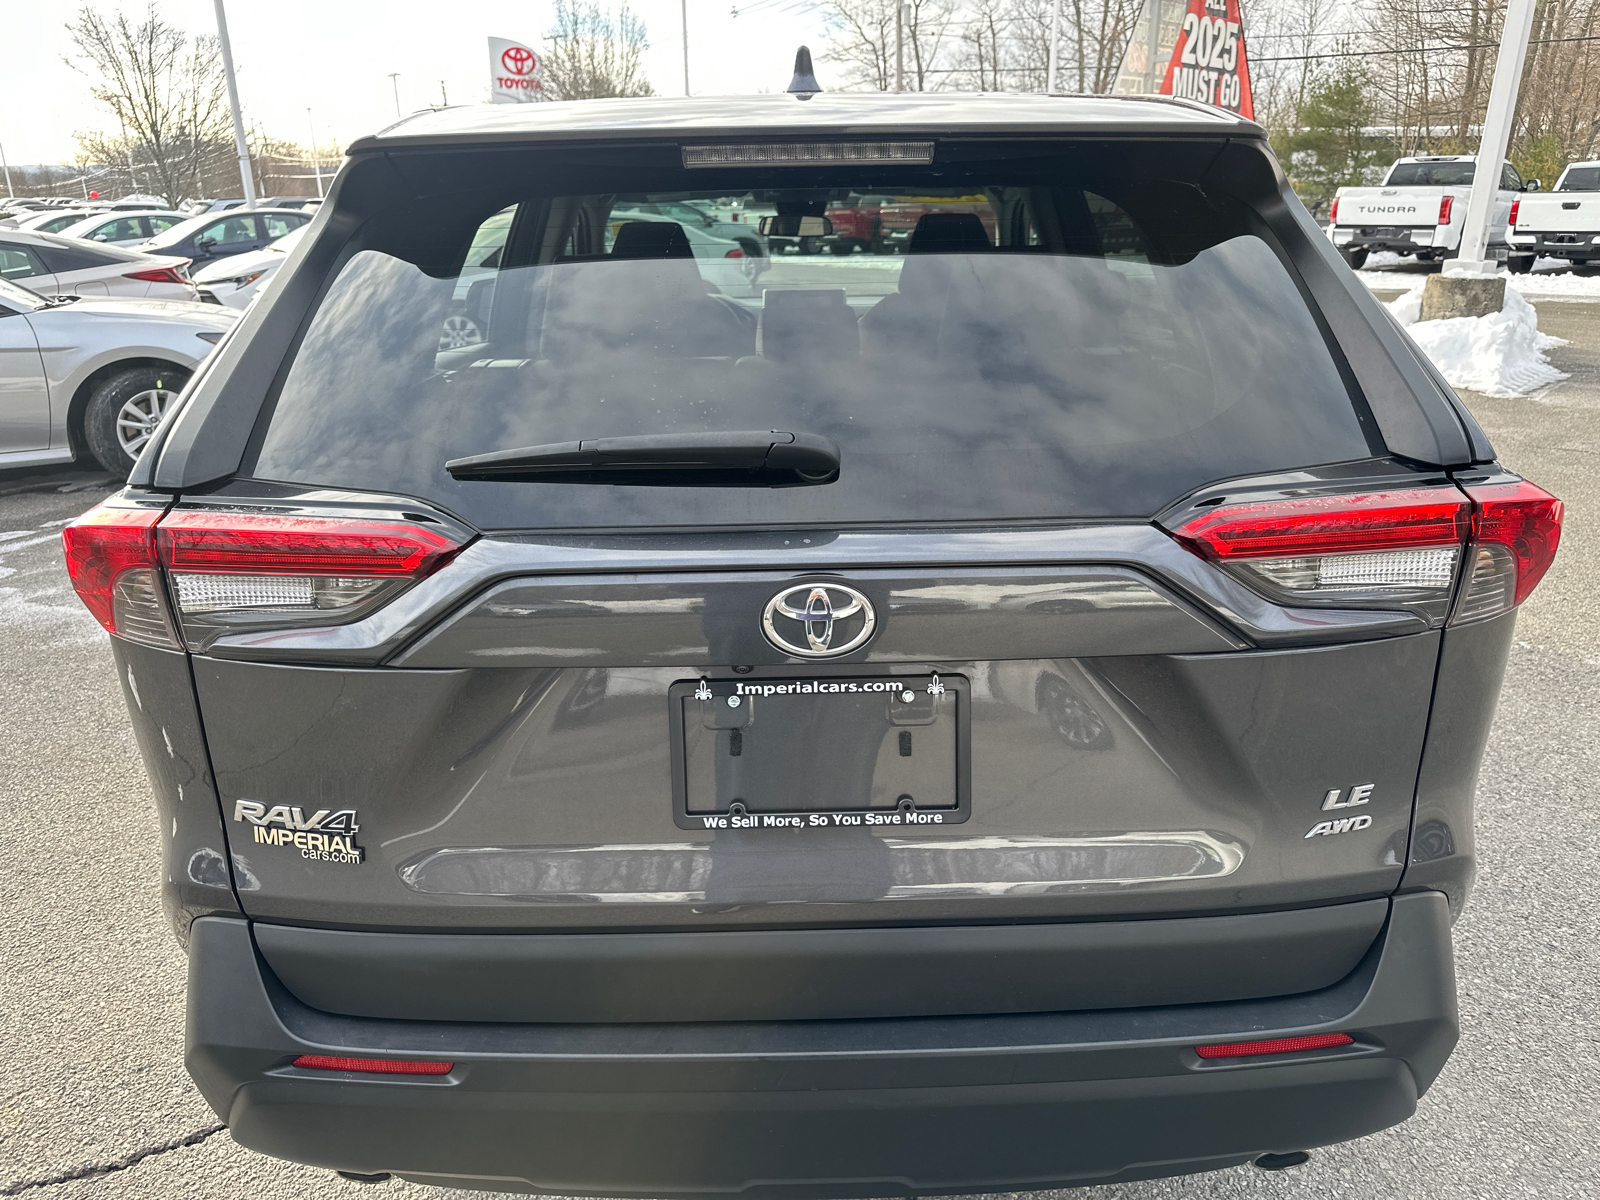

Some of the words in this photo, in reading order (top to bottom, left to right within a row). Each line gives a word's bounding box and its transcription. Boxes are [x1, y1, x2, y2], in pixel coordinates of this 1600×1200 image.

[1181, 13, 1239, 71] 2025
[496, 77, 544, 91] TOYOTA
[1173, 66, 1219, 104] MUST
[1220, 73, 1240, 108] GO
[736, 681, 904, 697] Imperialcars.com
[1321, 783, 1375, 811] LE
[234, 799, 360, 836] RAV4
[703, 817, 727, 828] We
[731, 816, 758, 828] Sell
[763, 815, 805, 829] More,
[809, 814, 828, 826] So
[832, 814, 860, 826] You
[865, 813, 901, 825] Save
[905, 812, 943, 824] More
[1304, 815, 1373, 839] AWD
[253, 825, 360, 855] IMPERIAL
[301, 848, 360, 865] cars.com
